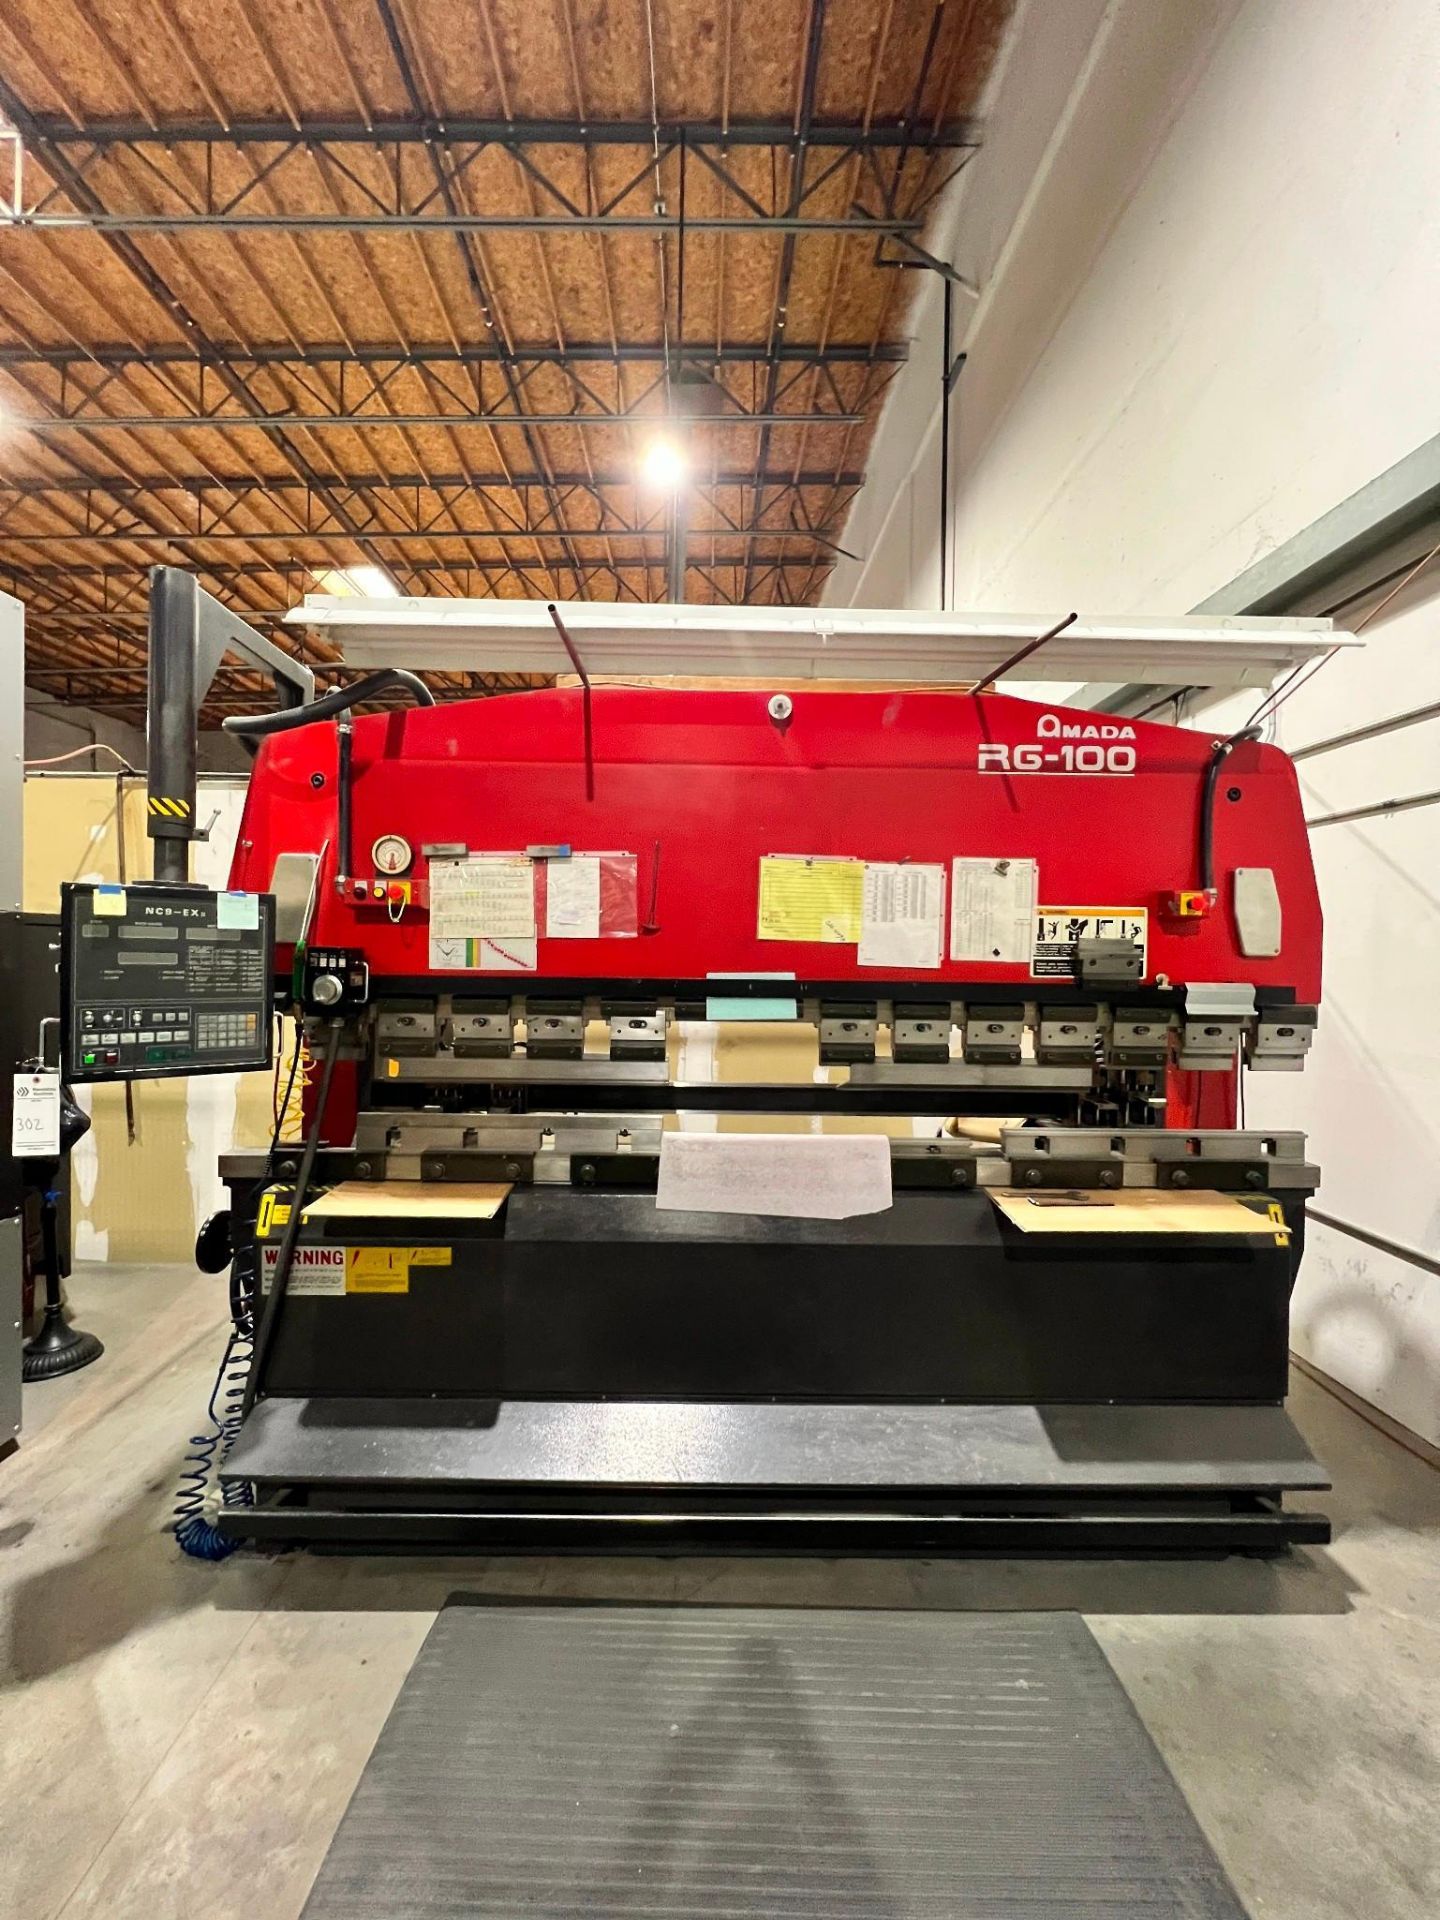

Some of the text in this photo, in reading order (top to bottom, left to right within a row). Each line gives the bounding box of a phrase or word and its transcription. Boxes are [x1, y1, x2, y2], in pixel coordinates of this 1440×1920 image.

[1037, 713, 1137, 739] AMADA
[978, 743, 1136, 772] RG-100
[16, 1117, 44, 1132] 302
[265, 1249, 344, 1265] WRNING
